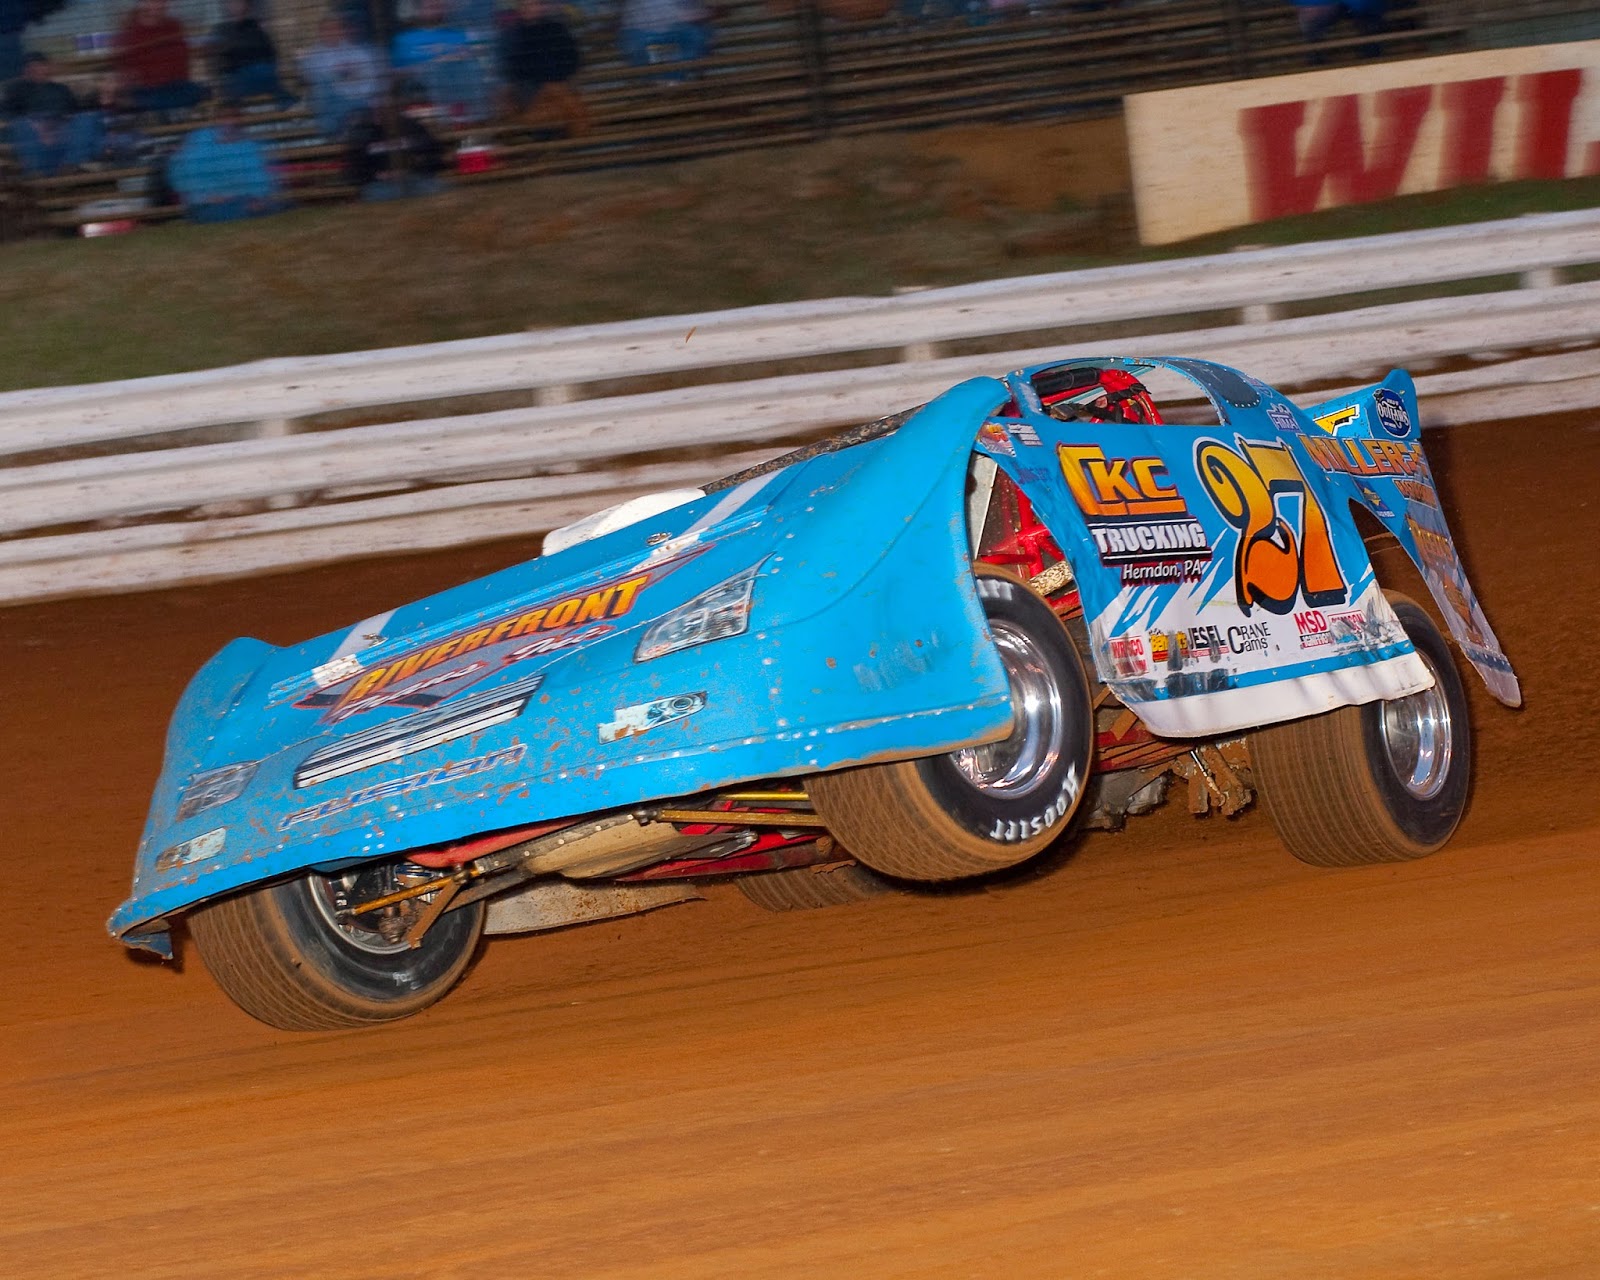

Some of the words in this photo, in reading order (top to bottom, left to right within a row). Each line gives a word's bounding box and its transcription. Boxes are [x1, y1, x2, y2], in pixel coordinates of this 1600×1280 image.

[1091, 523, 1207, 554] TRUCKING
[1123, 561, 1181, 581] Herndon,
[1183, 560, 1202, 576] PA
[1293, 610, 1328, 635] MSD
[333, 575, 649, 714] RIVERFRONT
